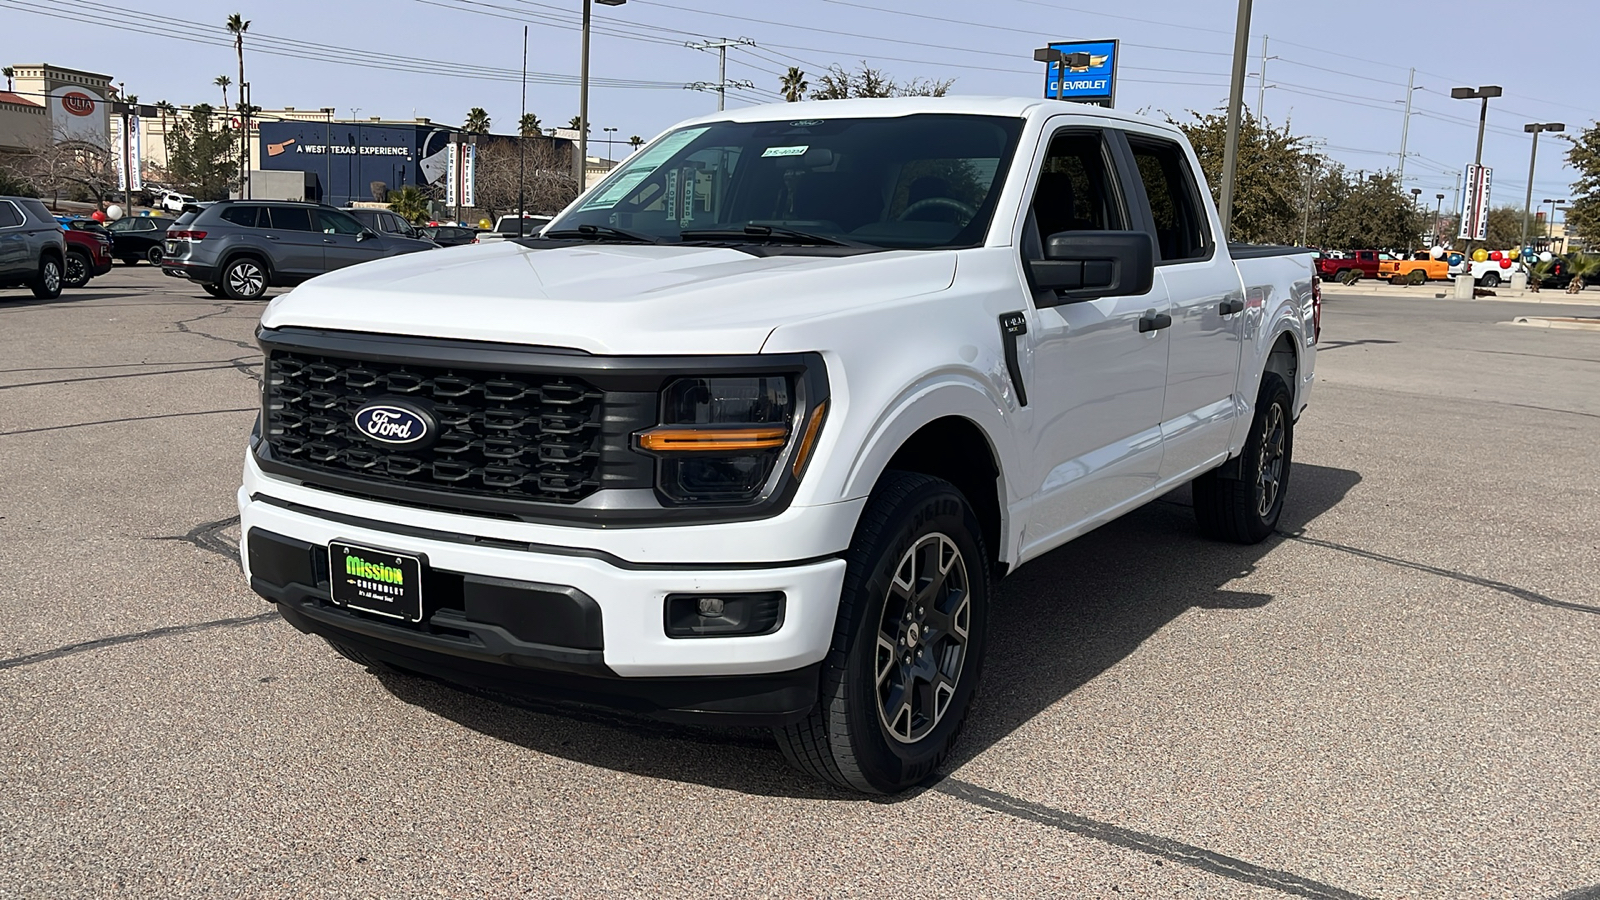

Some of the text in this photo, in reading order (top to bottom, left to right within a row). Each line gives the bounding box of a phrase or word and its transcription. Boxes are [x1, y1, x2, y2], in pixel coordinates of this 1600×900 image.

[1050, 80, 1107, 90] CEVROLET
[69, 96, 92, 111] ULTA
[296, 145, 408, 155] A WEST TEXAS EXPERIENCE
[1463, 167, 1474, 235] CERTIFIED
[1479, 170, 1490, 236] CERTIFIED
[367, 410, 412, 438] Ford
[357, 579, 403, 596] CHEVROLET
